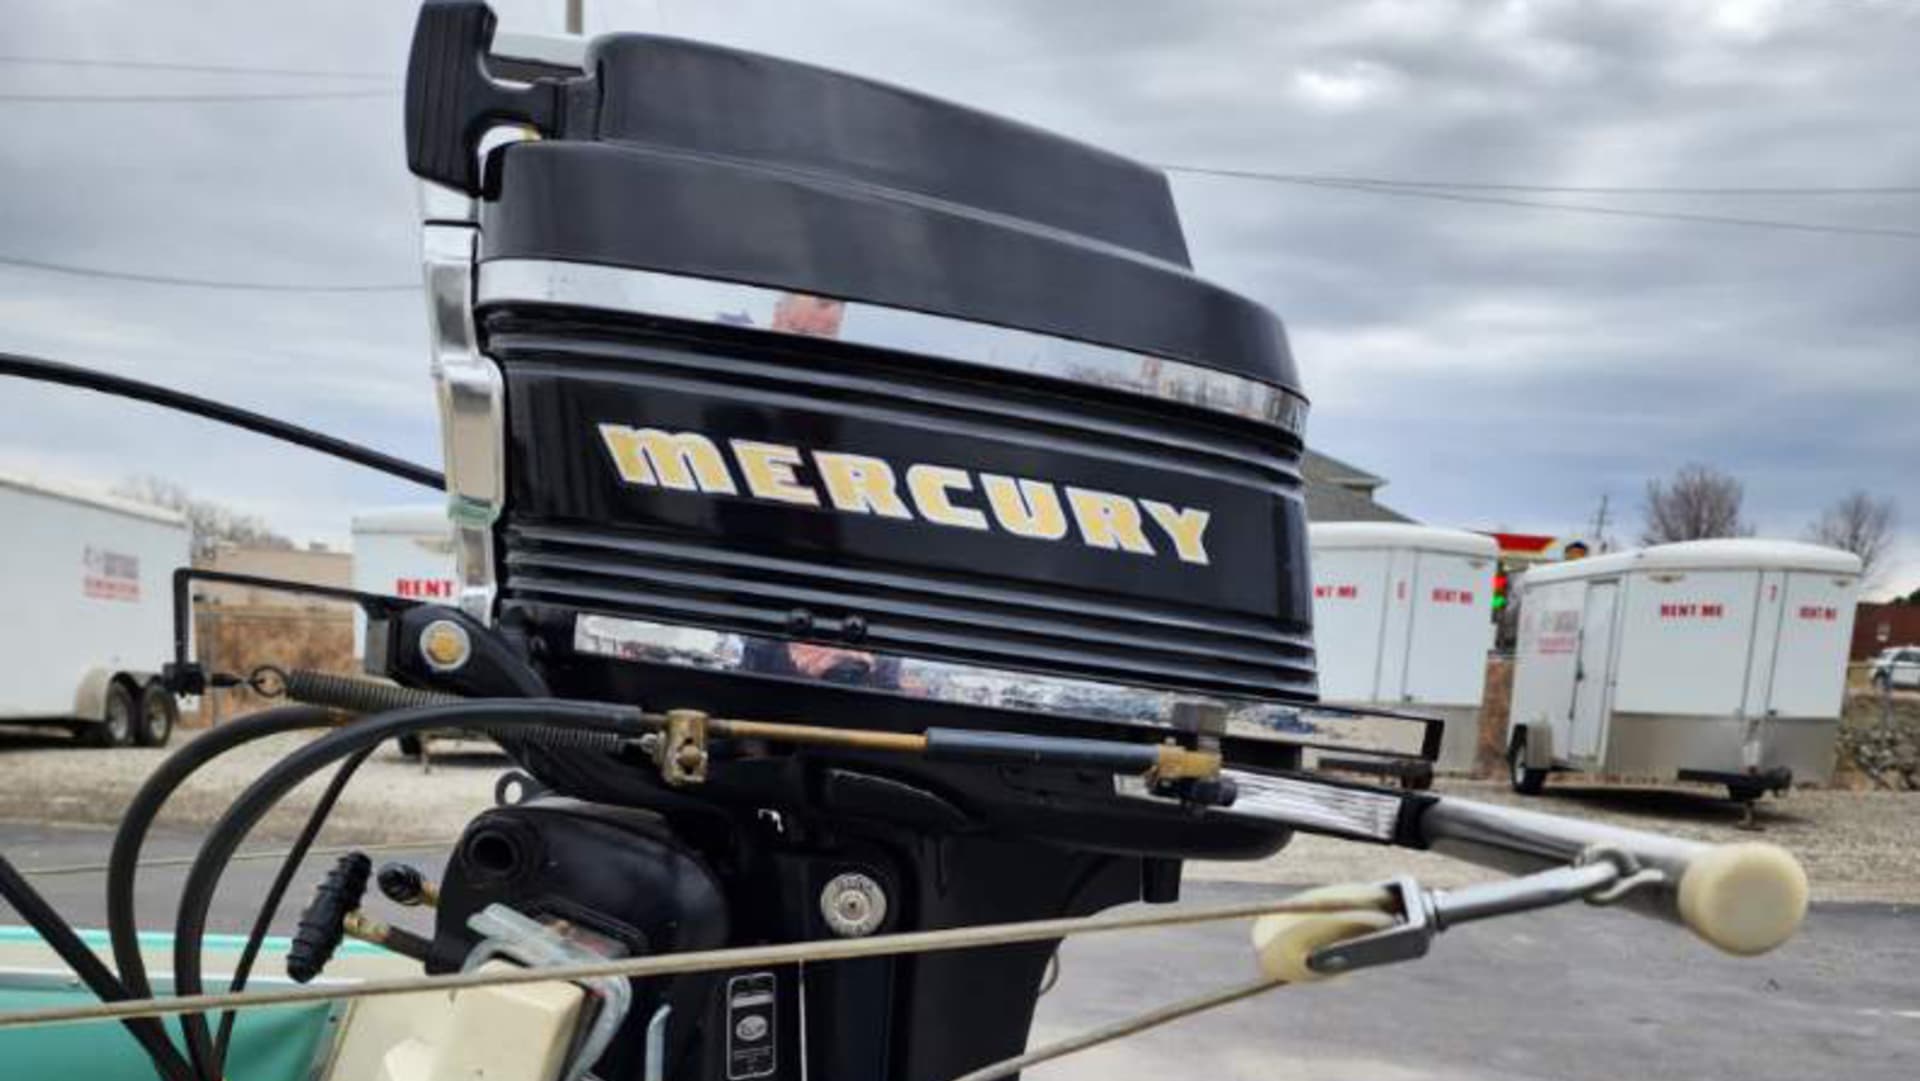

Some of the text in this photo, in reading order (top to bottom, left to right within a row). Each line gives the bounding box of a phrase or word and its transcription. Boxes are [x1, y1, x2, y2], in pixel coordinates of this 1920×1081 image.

[599, 423, 1211, 565] MERCURY
[396, 578, 453, 596] RENT
[1660, 604, 1697, 619] RENT
